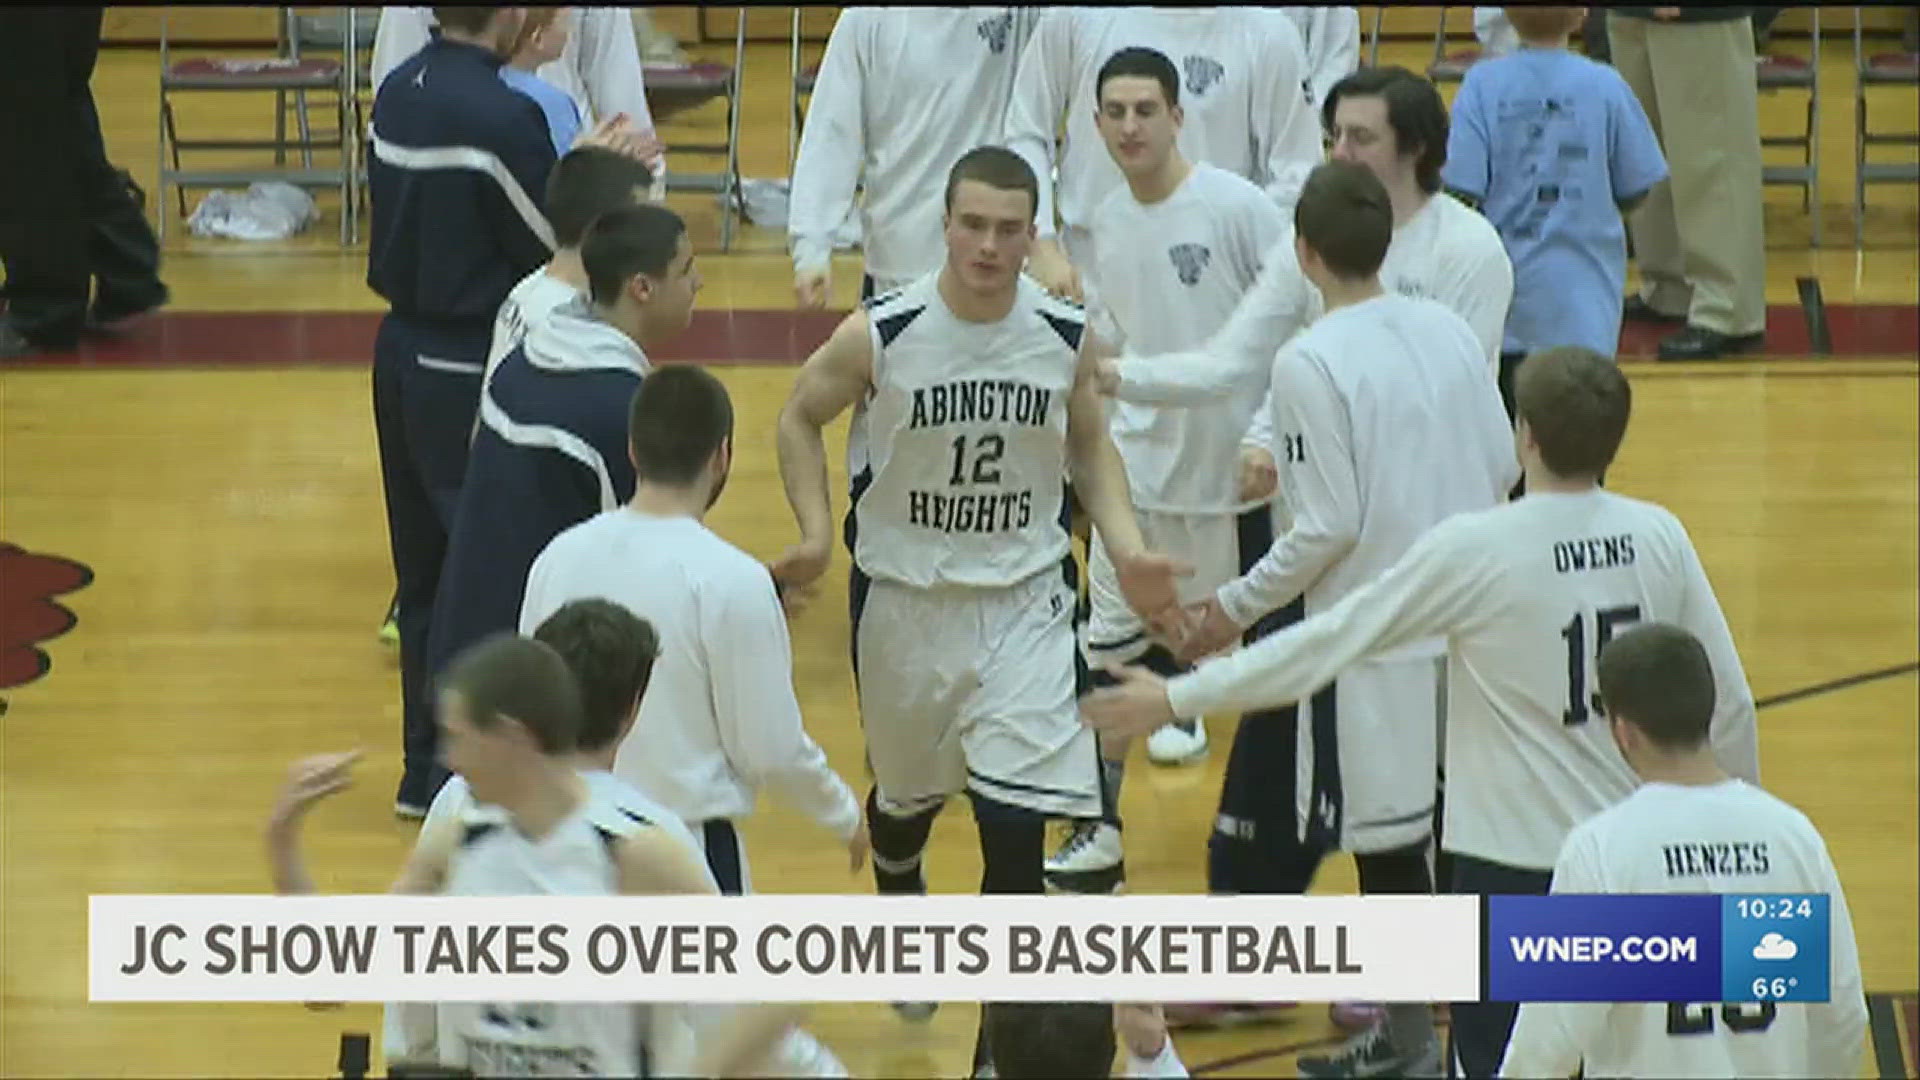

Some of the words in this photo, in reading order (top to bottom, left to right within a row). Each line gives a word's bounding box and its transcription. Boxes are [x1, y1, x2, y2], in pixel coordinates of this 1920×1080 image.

[910, 379, 1051, 430] ABINGTON
[949, 433, 1005, 486] 12
[908, 490, 1032, 534] HEIGHTS
[1553, 533, 1636, 574] OWENS
[1661, 842, 1770, 879] HENZES
